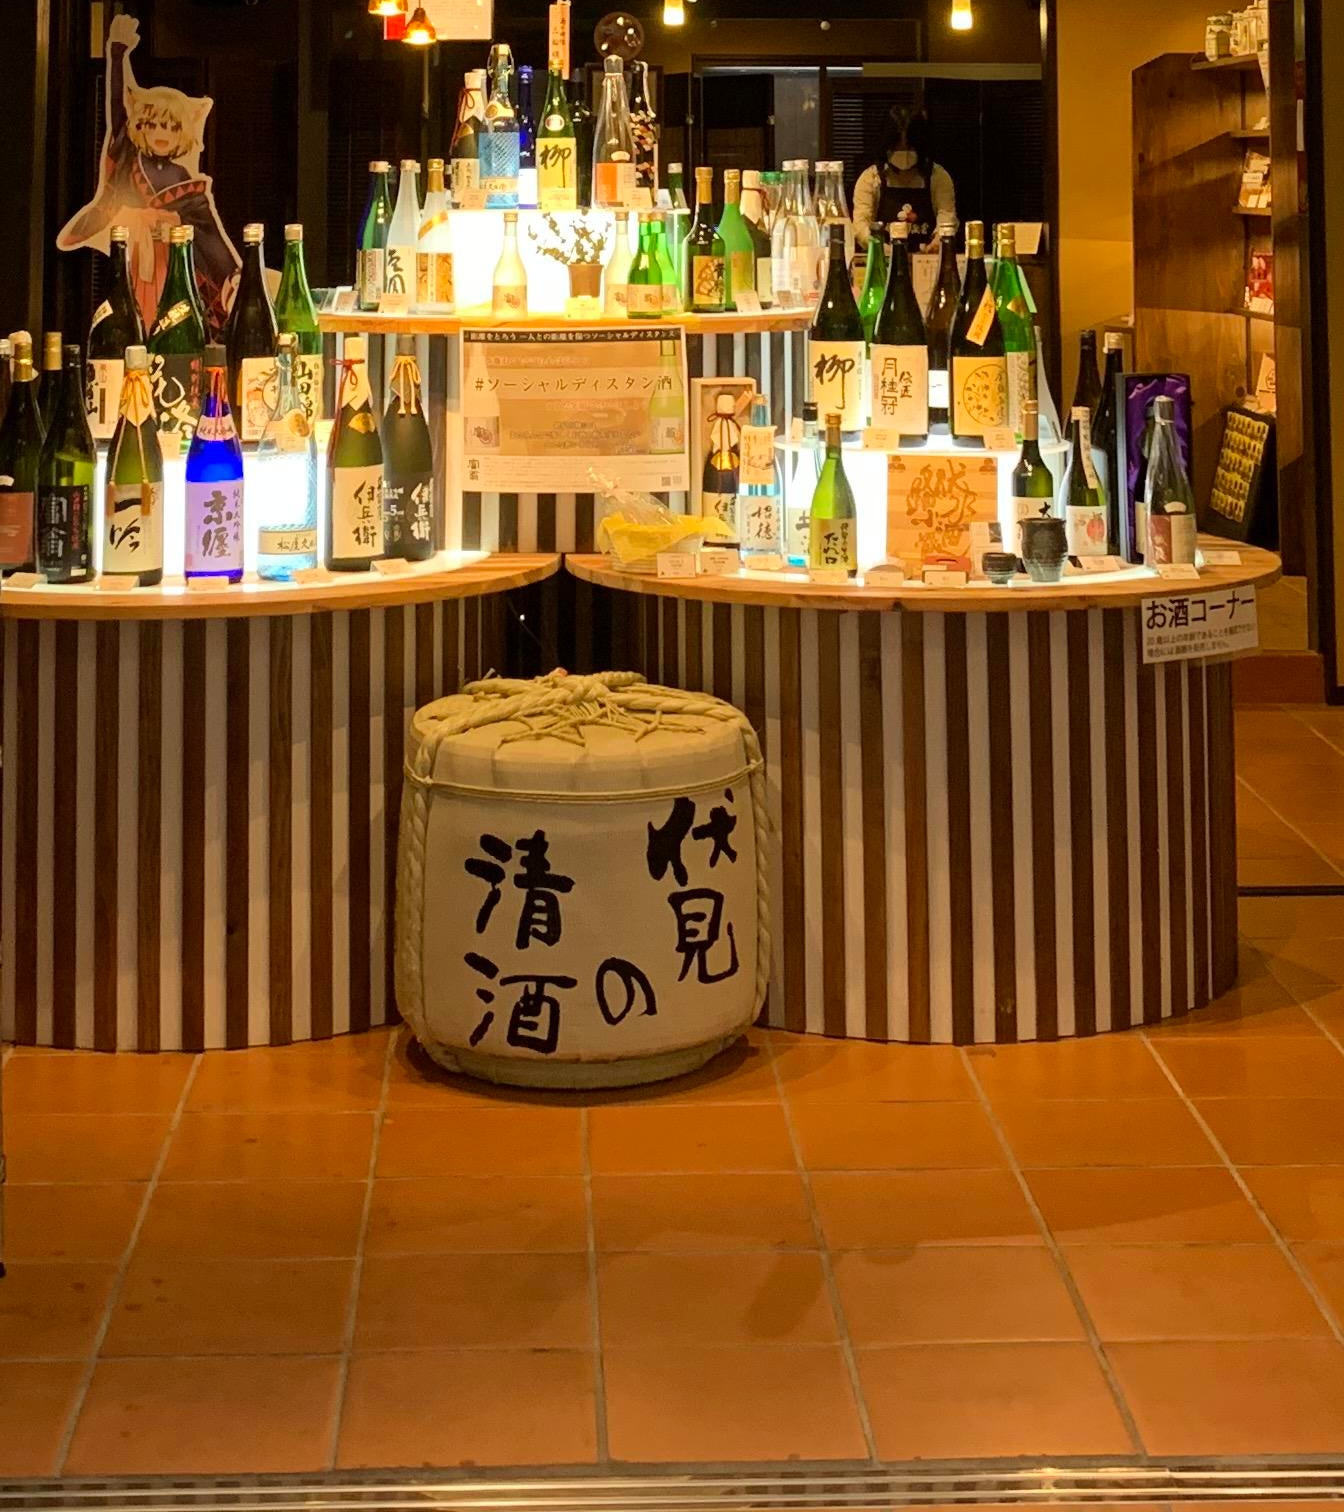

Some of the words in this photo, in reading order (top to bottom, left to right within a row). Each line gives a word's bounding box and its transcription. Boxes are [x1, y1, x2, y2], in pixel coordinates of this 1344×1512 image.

[540, 144, 571, 188] 柳
[475, 374, 673, 394] #ソーシャルディスタン酒
[814, 353, 855, 410] 柳
[881, 357, 898, 415] 月桂冠
[352, 480, 377, 548] 伊兵衛
[1146, 590, 1254, 629] お酒コーナー
[464, 828, 578, 1055] 清酒
